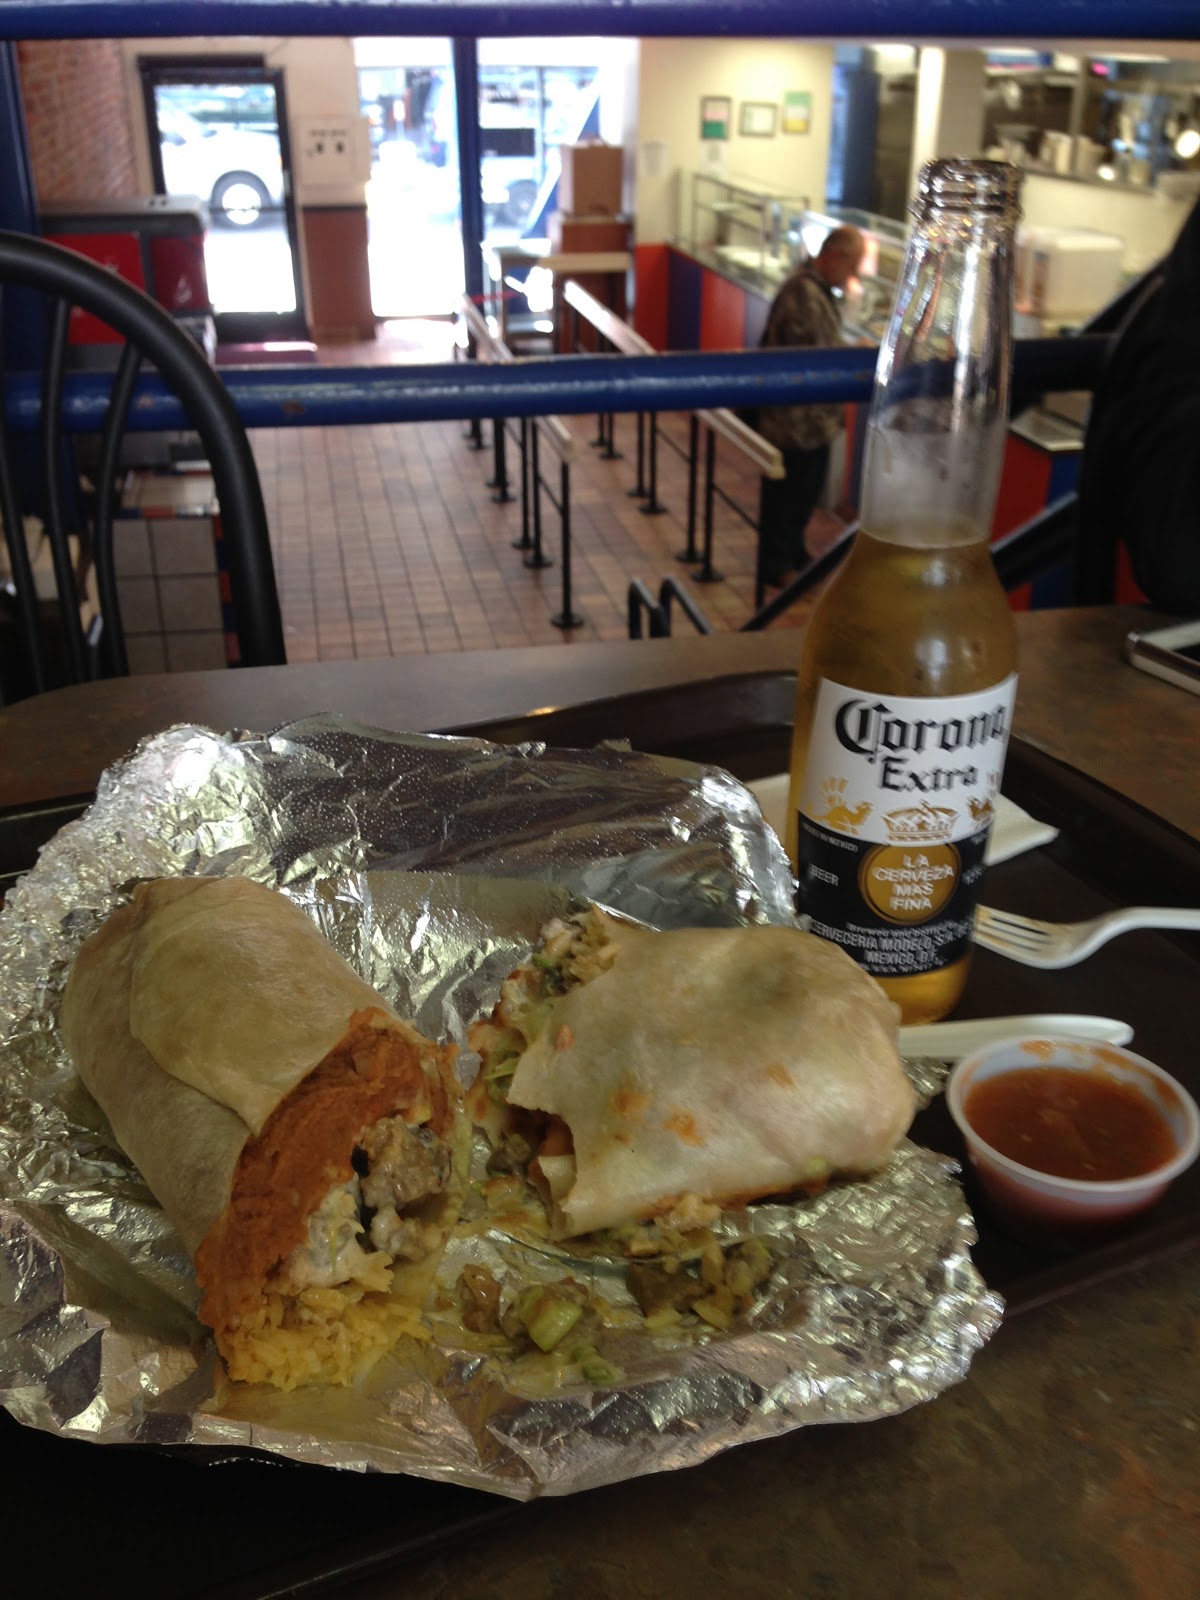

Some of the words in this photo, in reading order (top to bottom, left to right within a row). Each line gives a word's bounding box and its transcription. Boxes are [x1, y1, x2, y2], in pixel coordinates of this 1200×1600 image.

[835, 699, 1006, 764] Corona
[879, 756, 978, 793] Extra
[903, 854, 930, 868] LA
[808, 864, 840, 886] BEER
[872, 864, 954, 882] CERVEZA
[893, 882, 934, 897] MAS
[889, 895, 932, 910] FINA
